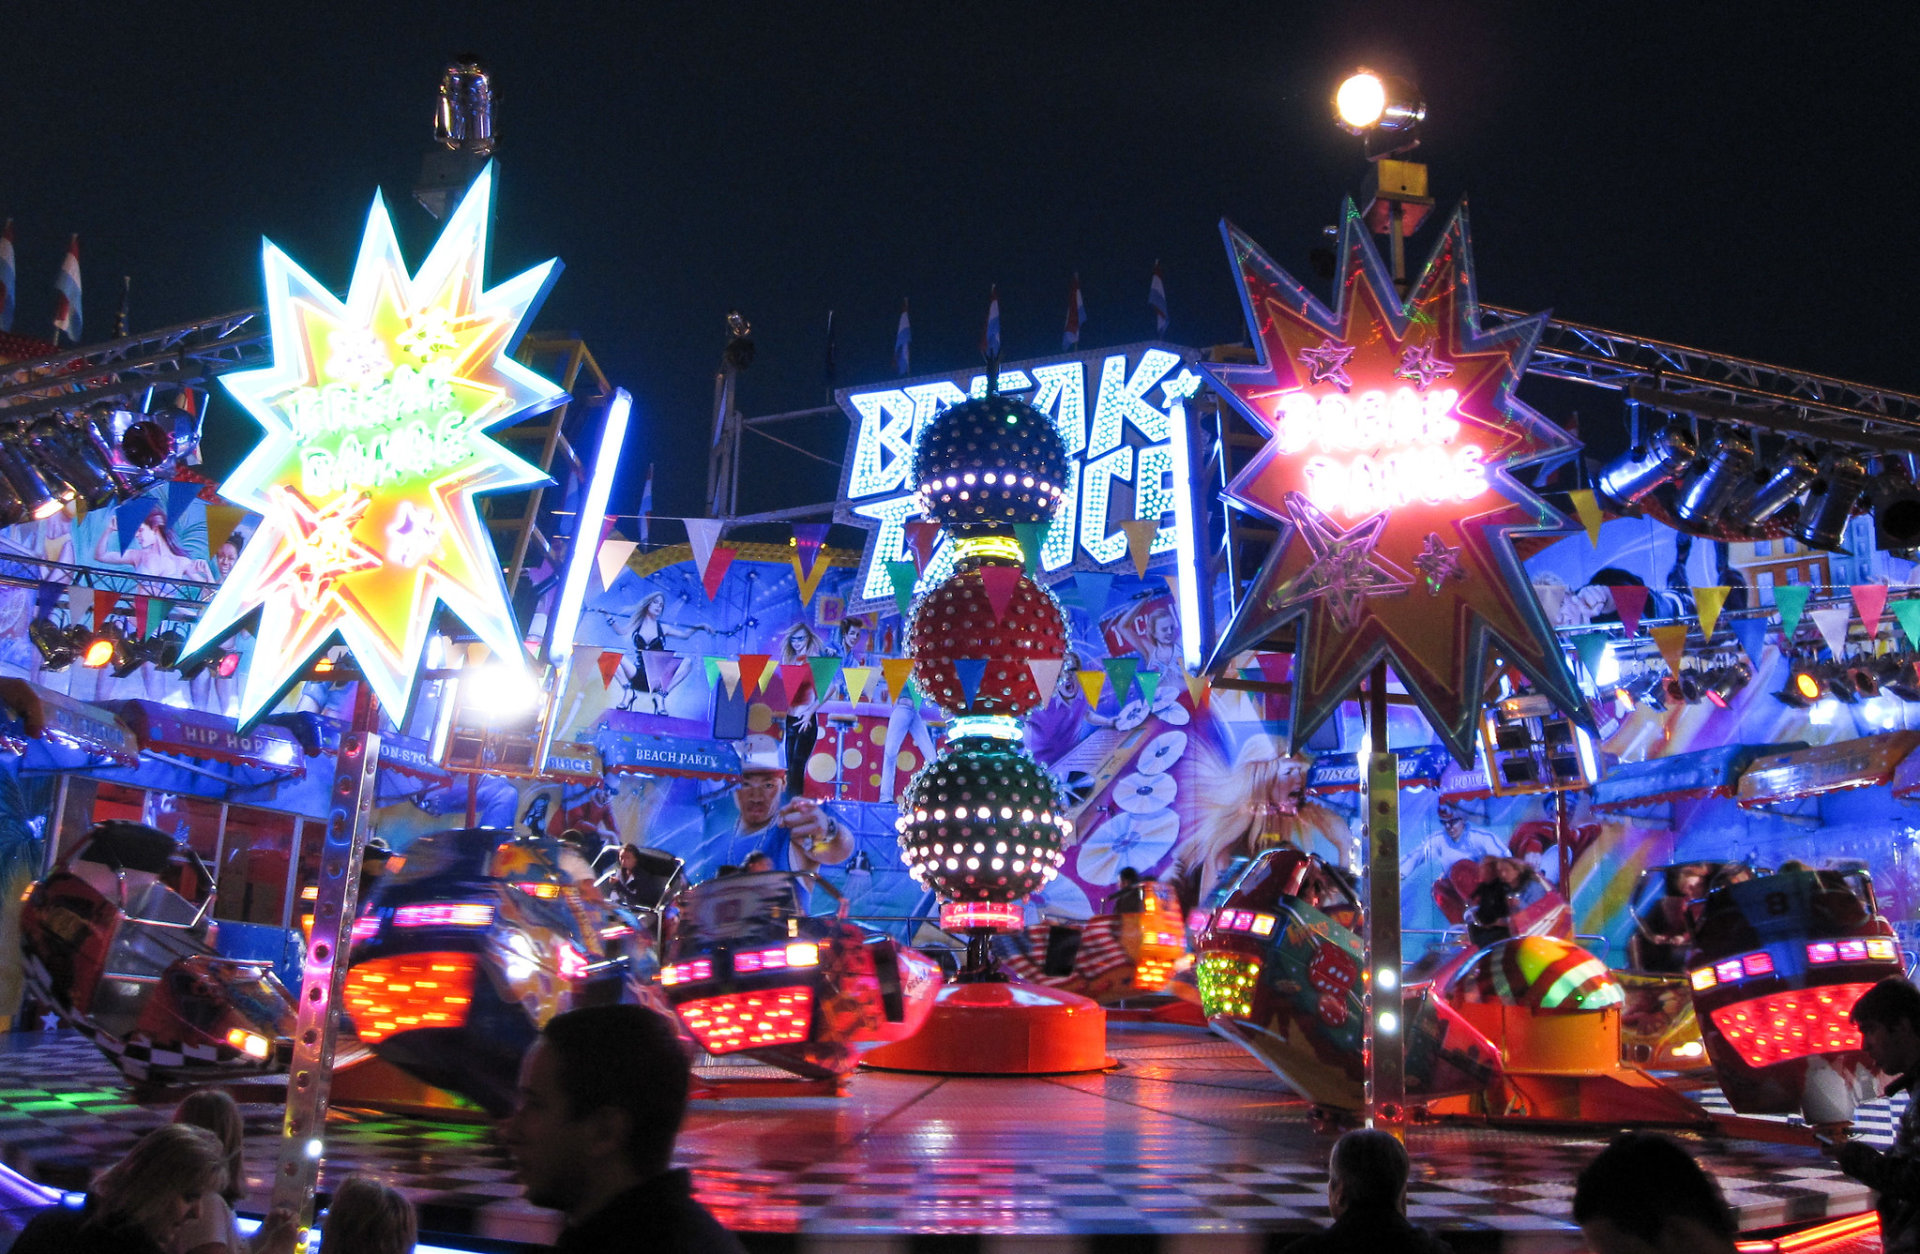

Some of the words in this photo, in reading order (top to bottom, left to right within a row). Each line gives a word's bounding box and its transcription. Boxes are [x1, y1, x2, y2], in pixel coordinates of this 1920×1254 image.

[847, 348, 1182, 500] BAK
[184, 726, 219, 744] HIP
[226, 734, 264, 753] HOP
[380, 744, 428, 766] ON-STO
[548, 755, 592, 774] ALACE
[636, 748, 676, 763] BEACH
[679, 753, 718, 769] PARTY
